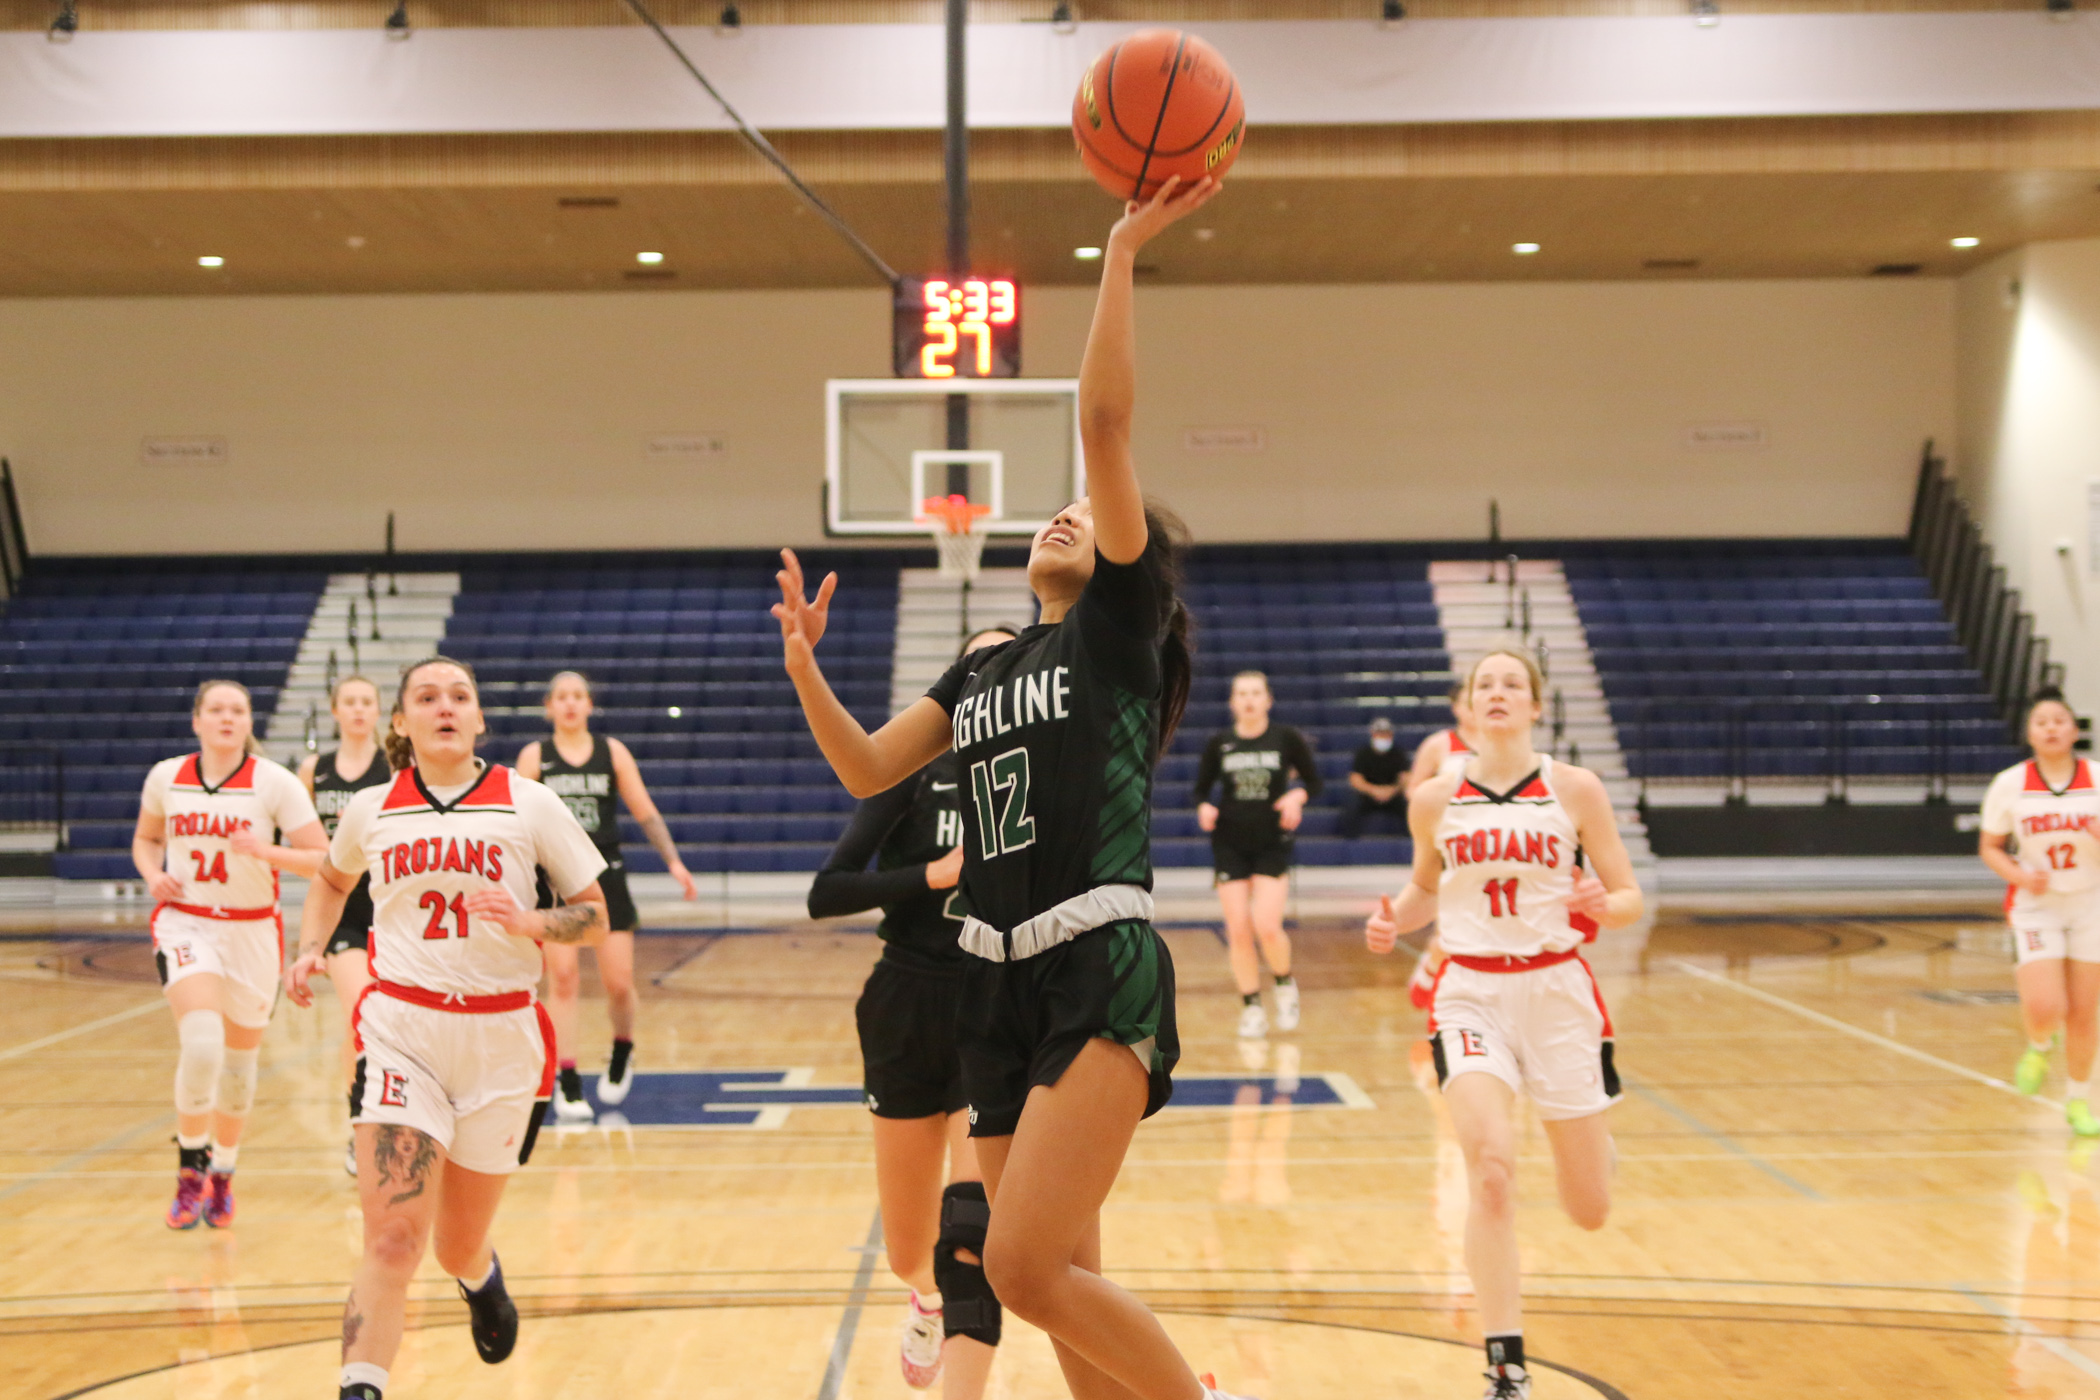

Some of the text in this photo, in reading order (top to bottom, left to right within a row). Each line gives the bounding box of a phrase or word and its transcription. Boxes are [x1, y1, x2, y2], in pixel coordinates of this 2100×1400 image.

[924, 280, 1016, 323] 5:33
[921, 320, 991, 378] 27
[952, 666, 1070, 753] IGHLINE
[970, 746, 1036, 861] 12
[191, 849, 228, 884] 24
[381, 836, 504, 885] TROJANS
[1444, 827, 1560, 871] TROJANS
[2046, 843, 2077, 870] 12
[418, 889, 469, 940] 21
[1482, 876, 1519, 918] 11
